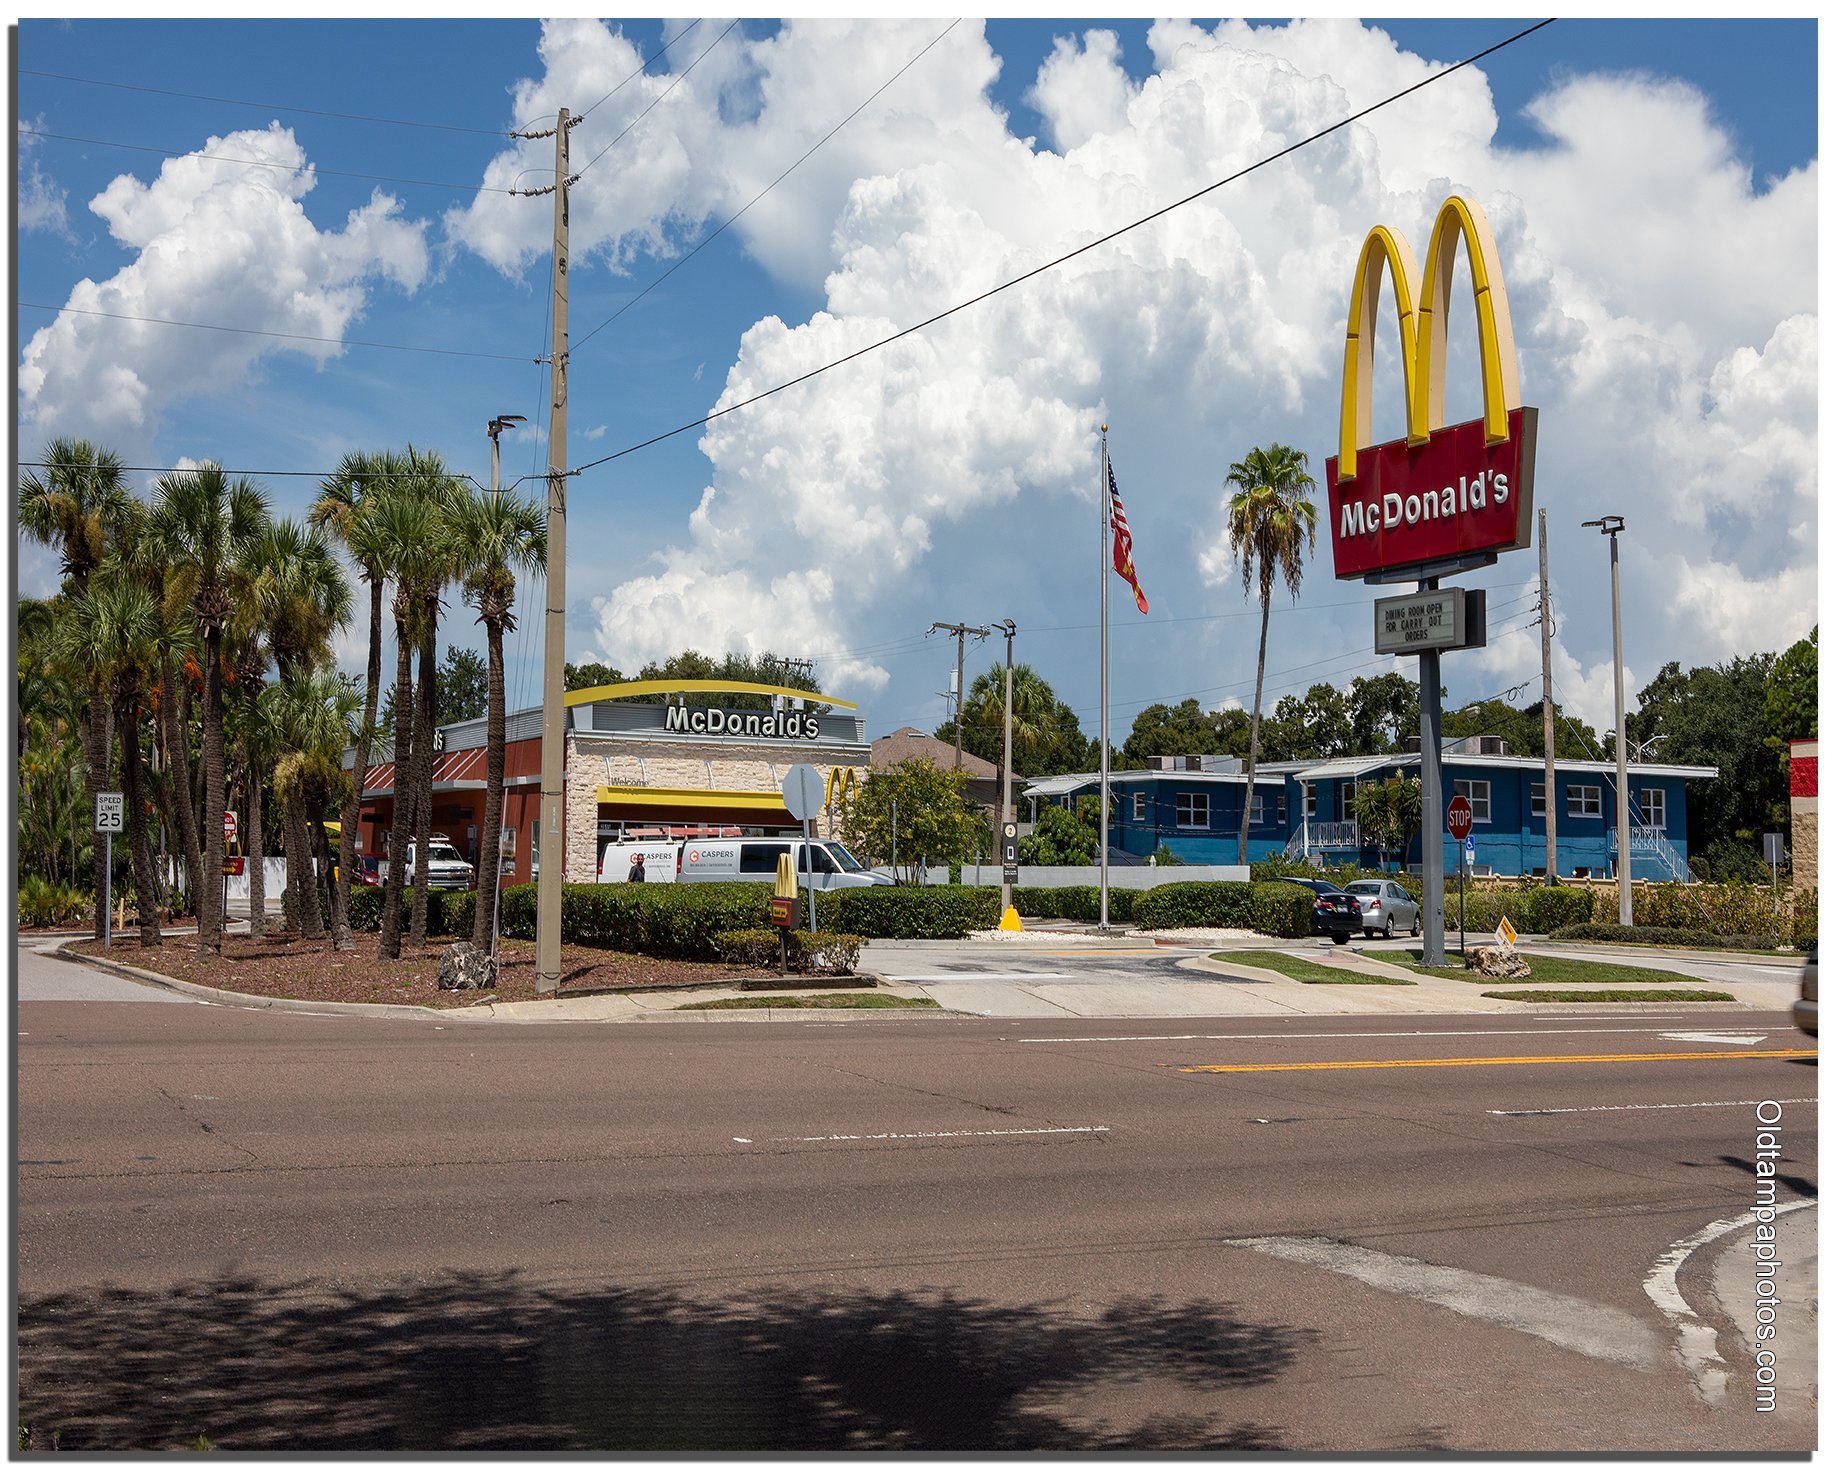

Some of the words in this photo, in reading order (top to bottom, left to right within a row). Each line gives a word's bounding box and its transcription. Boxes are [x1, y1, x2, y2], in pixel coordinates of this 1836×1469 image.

[1340, 469, 1509, 539] McDonald's
[1385, 608, 1405, 620] DINING
[1408, 605, 1425, 617] ROOM
[1426, 603, 1443, 615] OPEN
[1385, 621, 1397, 632] FOR
[1401, 617, 1423, 630] CARRY
[1428, 615, 1442, 627] OUT
[1405, 629, 1428, 642] ORDERS
[664, 704, 820, 740] McDonald's
[98, 796, 122, 804] SPEED
[101, 804, 119, 812] LIMIT
[98, 812, 121, 827] 25
[1449, 809, 1471, 826] STOP
[1007, 827, 1013, 835] 2
[701, 850, 734, 858] CASPERS
